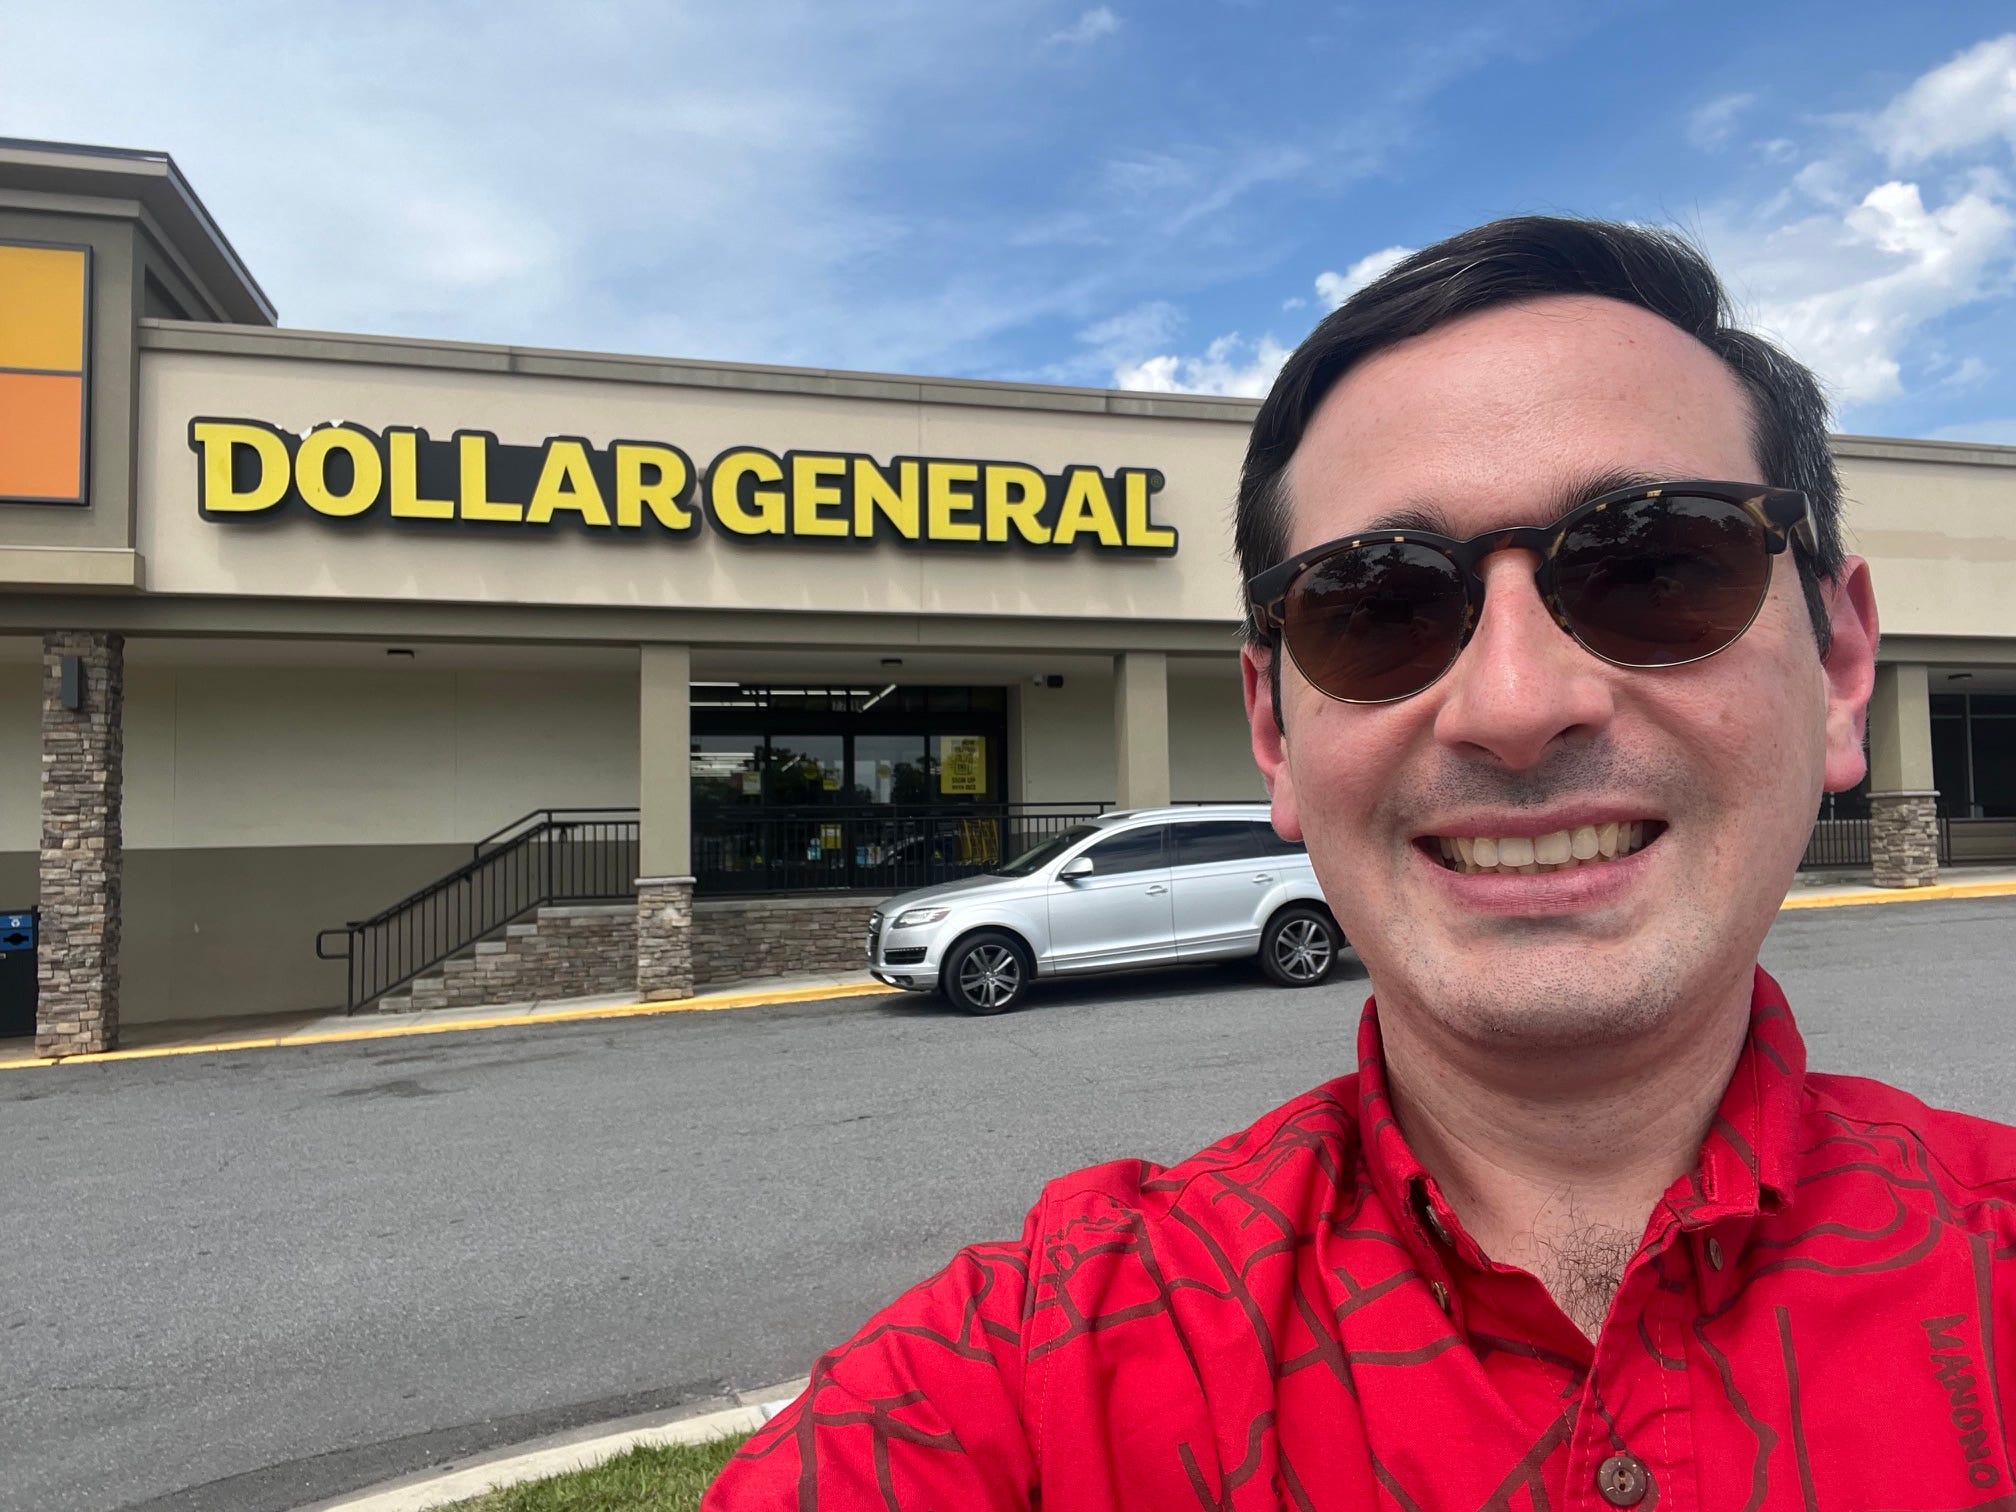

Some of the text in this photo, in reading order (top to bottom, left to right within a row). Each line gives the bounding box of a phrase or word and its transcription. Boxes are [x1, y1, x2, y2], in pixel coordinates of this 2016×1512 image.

[194, 423, 1175, 548] DOLLAR GENERAL
[1919, 1312, 2000, 1489] MANONO
